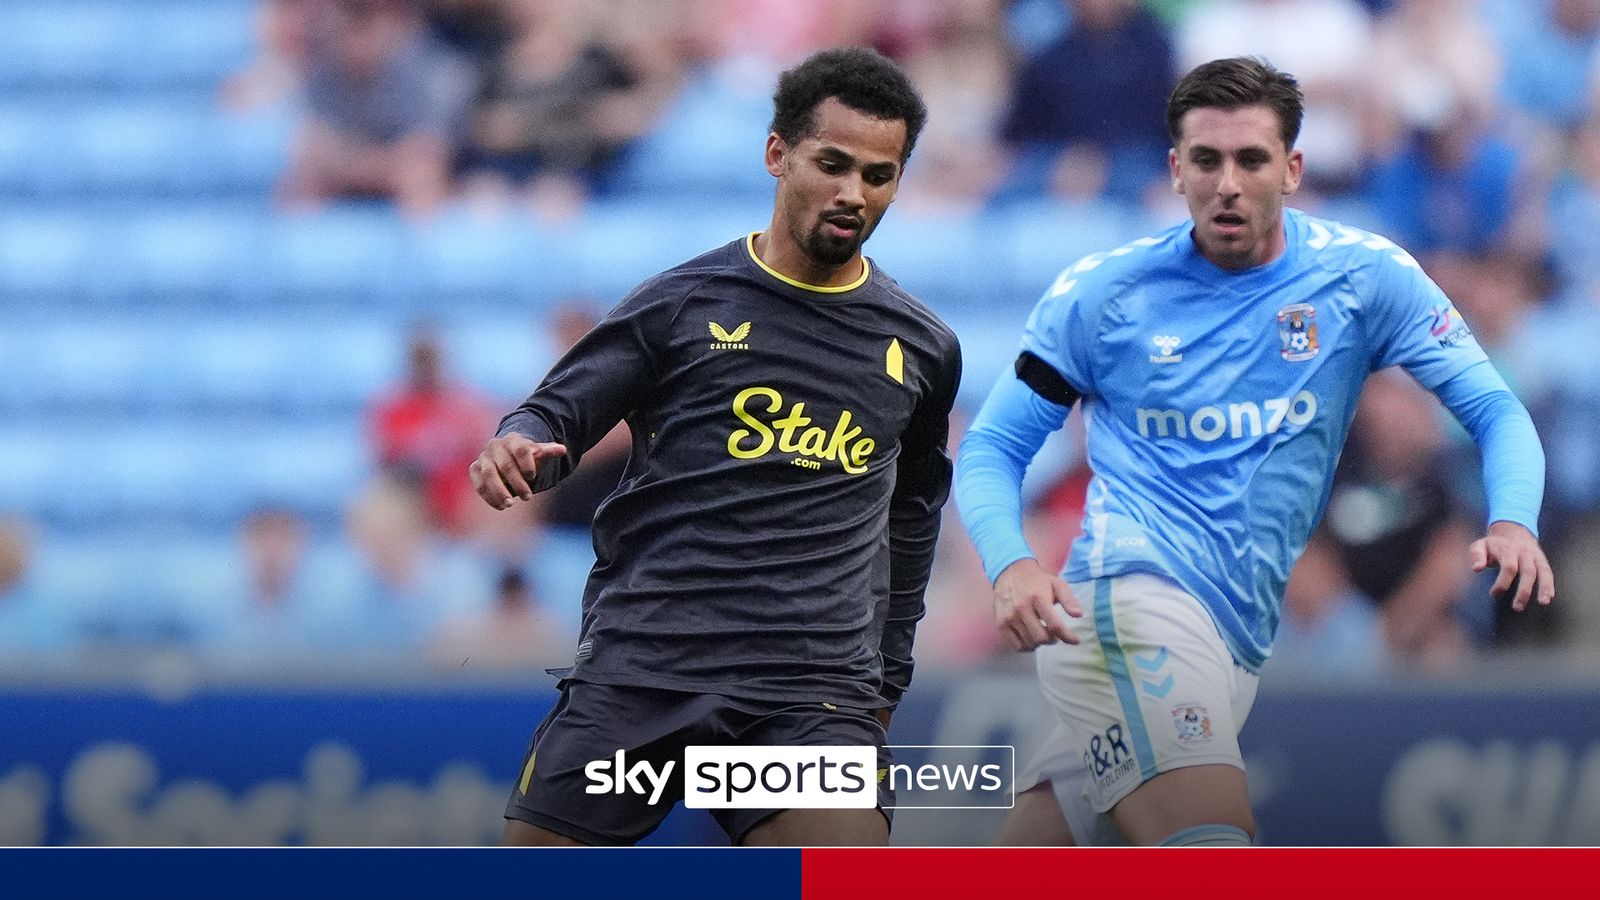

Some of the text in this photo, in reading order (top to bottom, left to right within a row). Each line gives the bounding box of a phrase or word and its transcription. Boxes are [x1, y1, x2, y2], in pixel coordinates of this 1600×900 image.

[727, 386, 876, 475] Stake
[1136, 389, 1318, 442] monzo
[790, 456, 821, 471] .com
